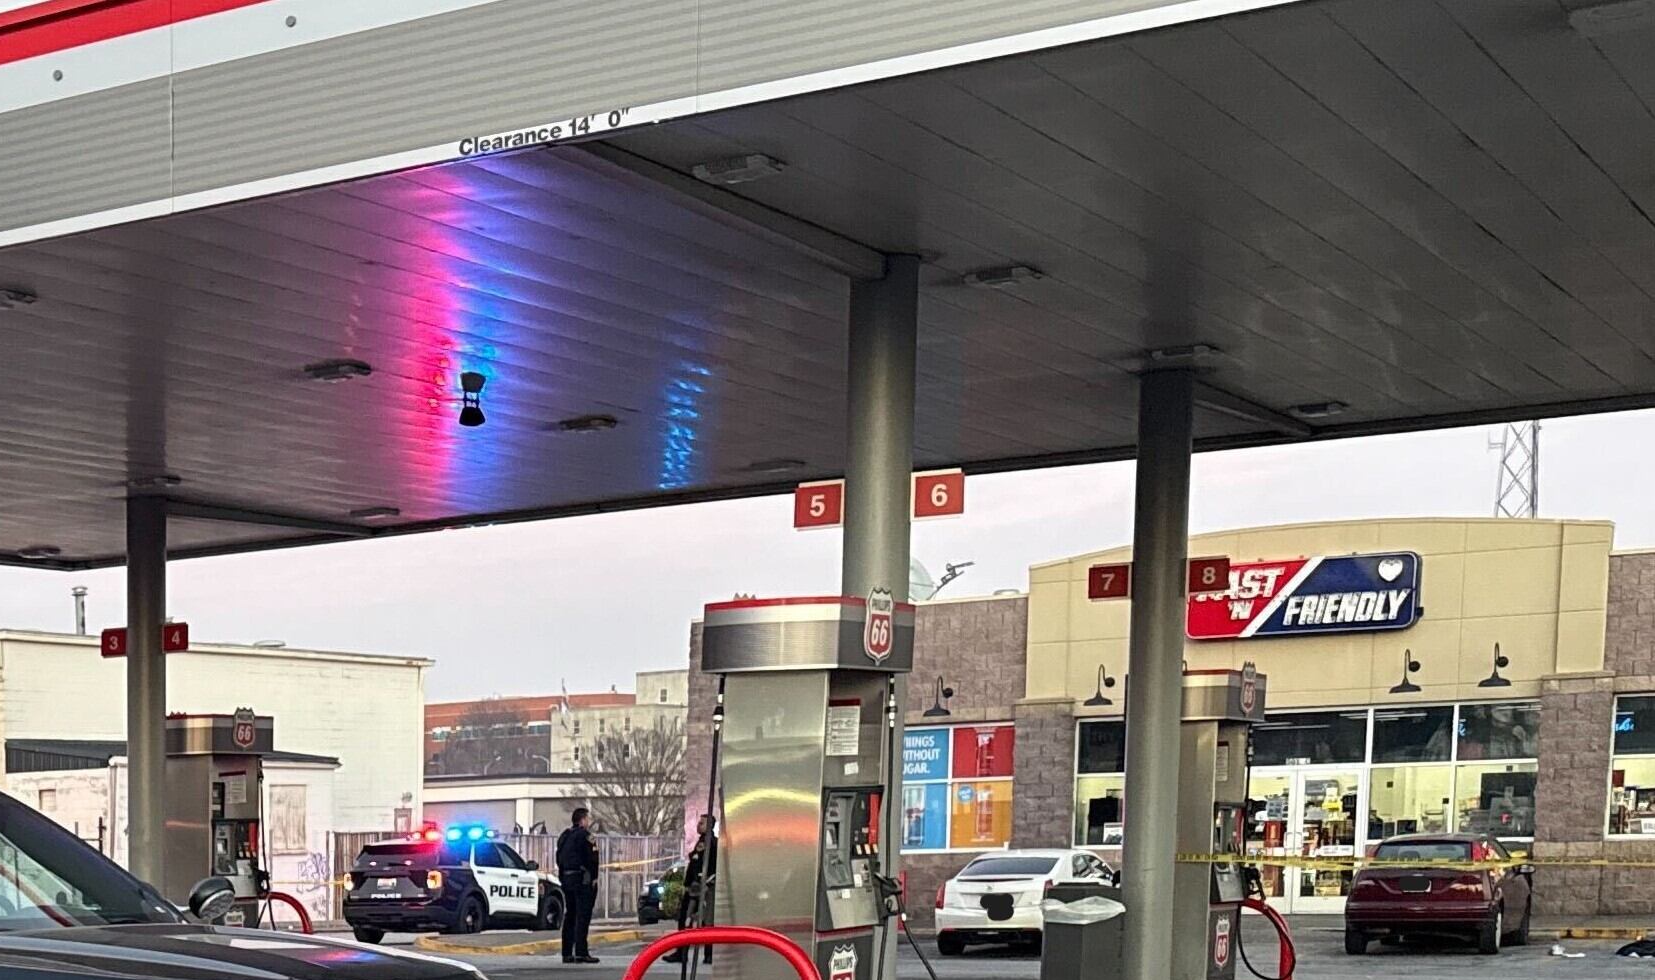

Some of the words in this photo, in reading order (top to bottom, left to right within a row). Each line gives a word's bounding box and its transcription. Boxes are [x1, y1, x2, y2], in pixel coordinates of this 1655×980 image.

[459, 125, 562, 156] Clearance
[569, 114, 595, 135] 14'
[608, 106, 630, 127] 0"
[809, 494, 826, 517] 5
[931, 483, 949, 507] 6
[1101, 573, 1115, 591] 7
[1196, 567, 1285, 602] AST
[1202, 566, 1216, 585] 8
[1283, 588, 1411, 626] FRIENDLY
[109, 636, 118, 650] 3
[171, 630, 180, 645] 4
[871, 619, 889, 646] 66
[237, 725, 251, 741] 66
[490, 885, 536, 898] POLICE
